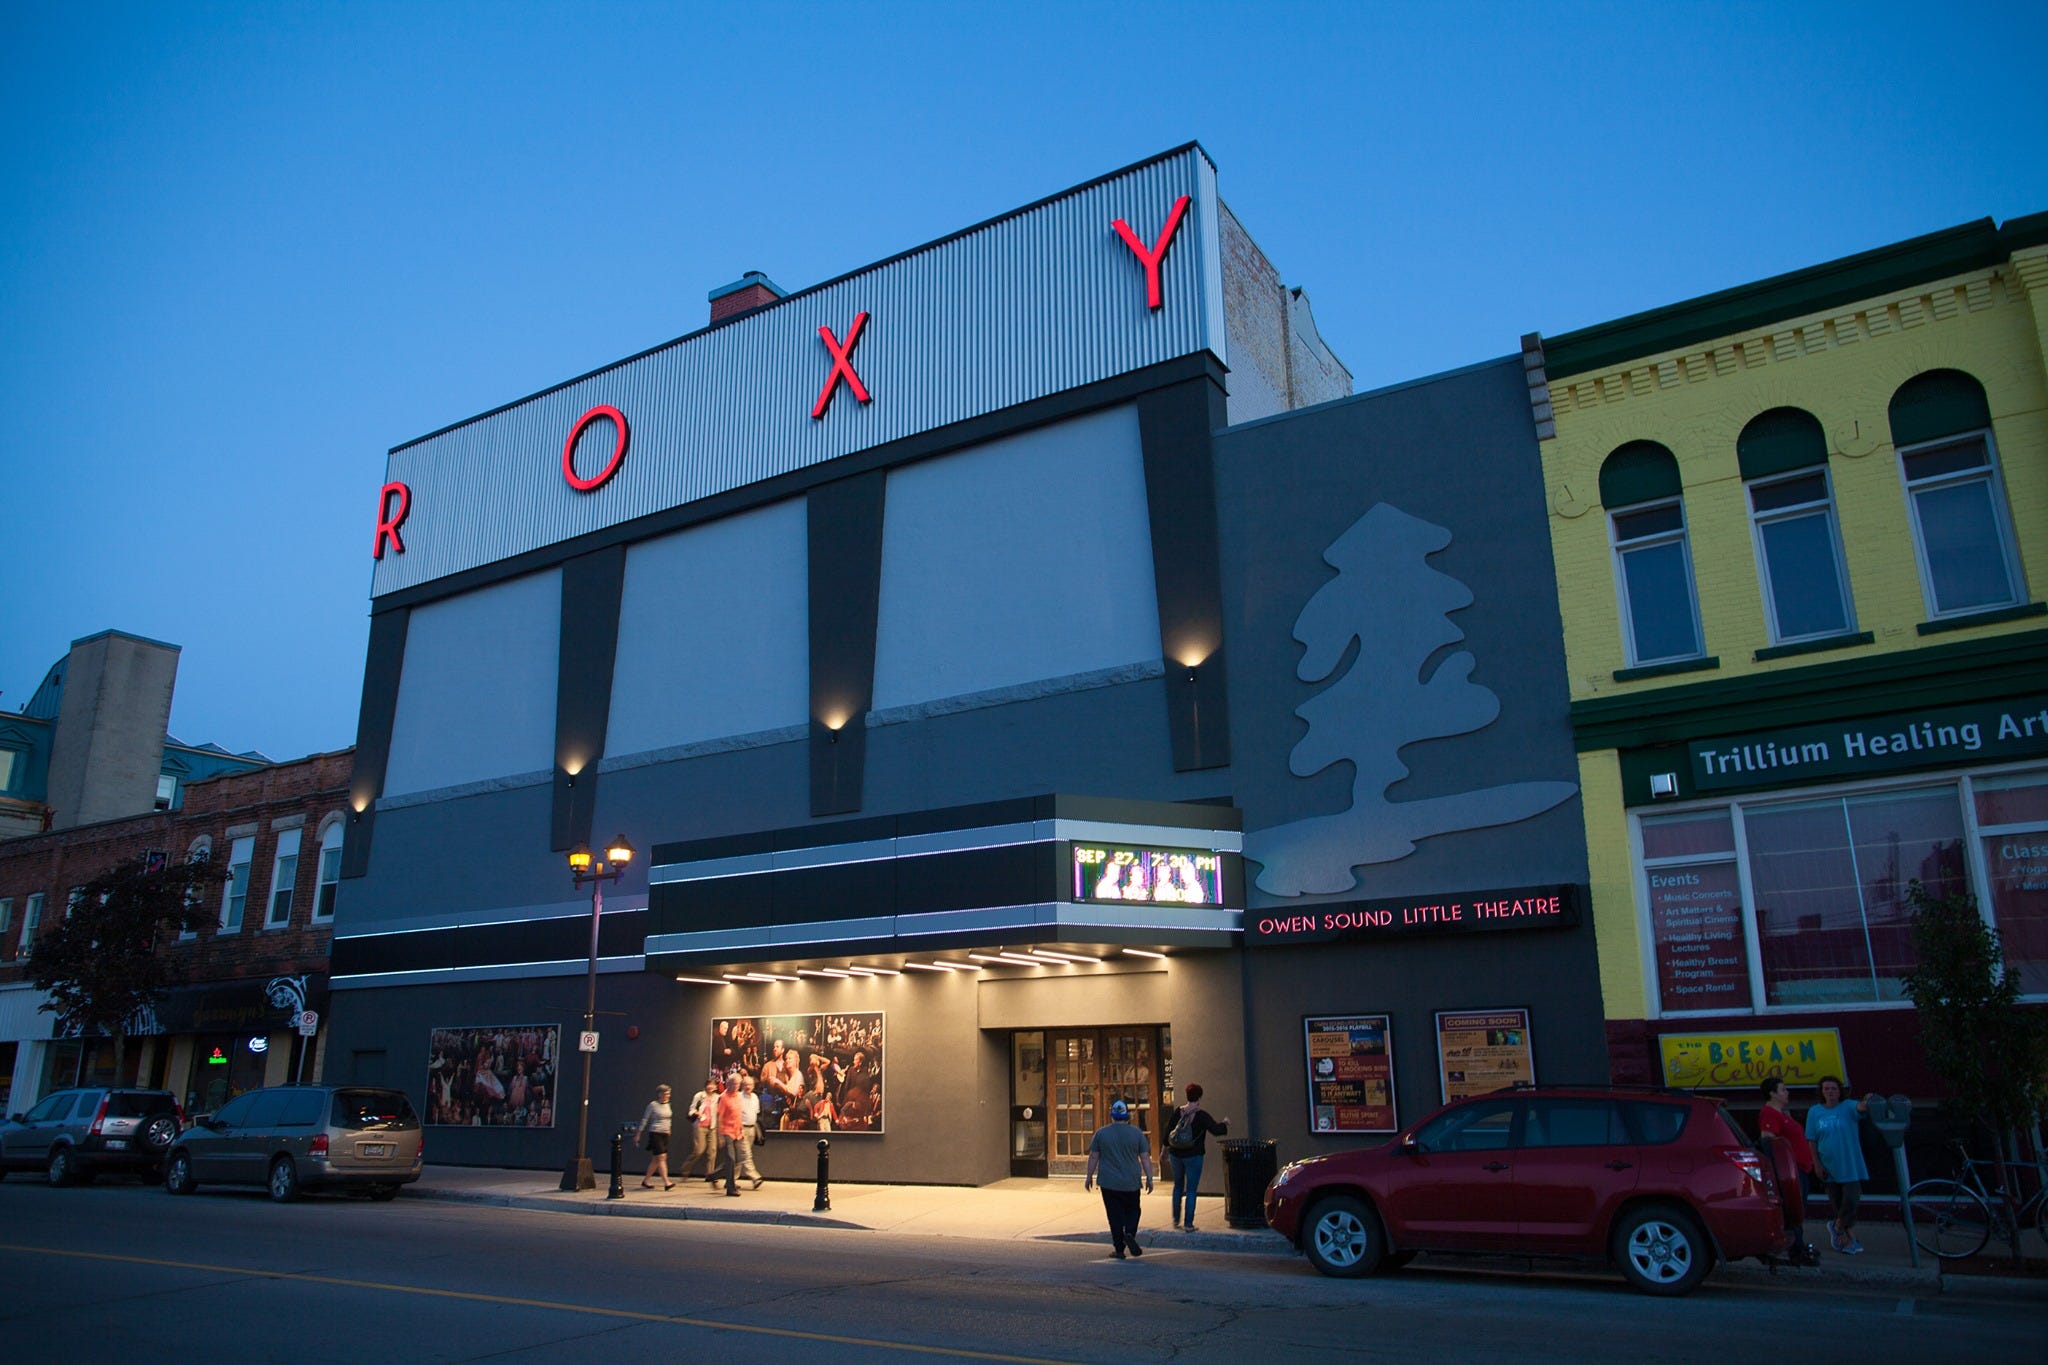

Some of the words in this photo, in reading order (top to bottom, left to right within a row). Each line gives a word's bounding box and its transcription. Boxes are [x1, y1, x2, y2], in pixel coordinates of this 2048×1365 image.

[373, 194, 1191, 560] ROXY
[1699, 742, 1829, 775] Trillium
[1843, 721, 1982, 758] Healing
[1076, 848, 1106, 863] SEP
[1151, 853, 1188, 868] 7:30
[1195, 856, 1216, 871] PM
[1651, 873, 1700, 887] Events
[1663, 893, 1689, 902] Music
[1691, 889, 1732, 900] Concerts
[1258, 915, 1316, 935] OWEN
[1323, 909, 1393, 930] SOUND
[1403, 903, 1463, 924] LITTLE
[1472, 896, 1561, 919] THEATRE
[1665, 907, 1680, 915] Art
[1681, 905, 1714, 914] Matters
[1665, 917, 1703, 928] Spiritual
[1704, 915, 1739, 924] Cinema
[1668, 932, 1702, 943] Healthy
[1704, 931, 1732, 941] Living
[1671, 943, 1710, 953] Lectures
[1672, 958, 1706, 968] Healthy
[1707, 956, 1738, 966] Breast
[1674, 969, 1714, 979] Program
[1675, 985, 1704, 994] Space
[1705, 982, 1735, 993] Rental
[1447, 1018, 1486, 1027] COMING
[1488, 1017, 1517, 1025] SOON
[1710, 1061, 1815, 1084] Cellar
